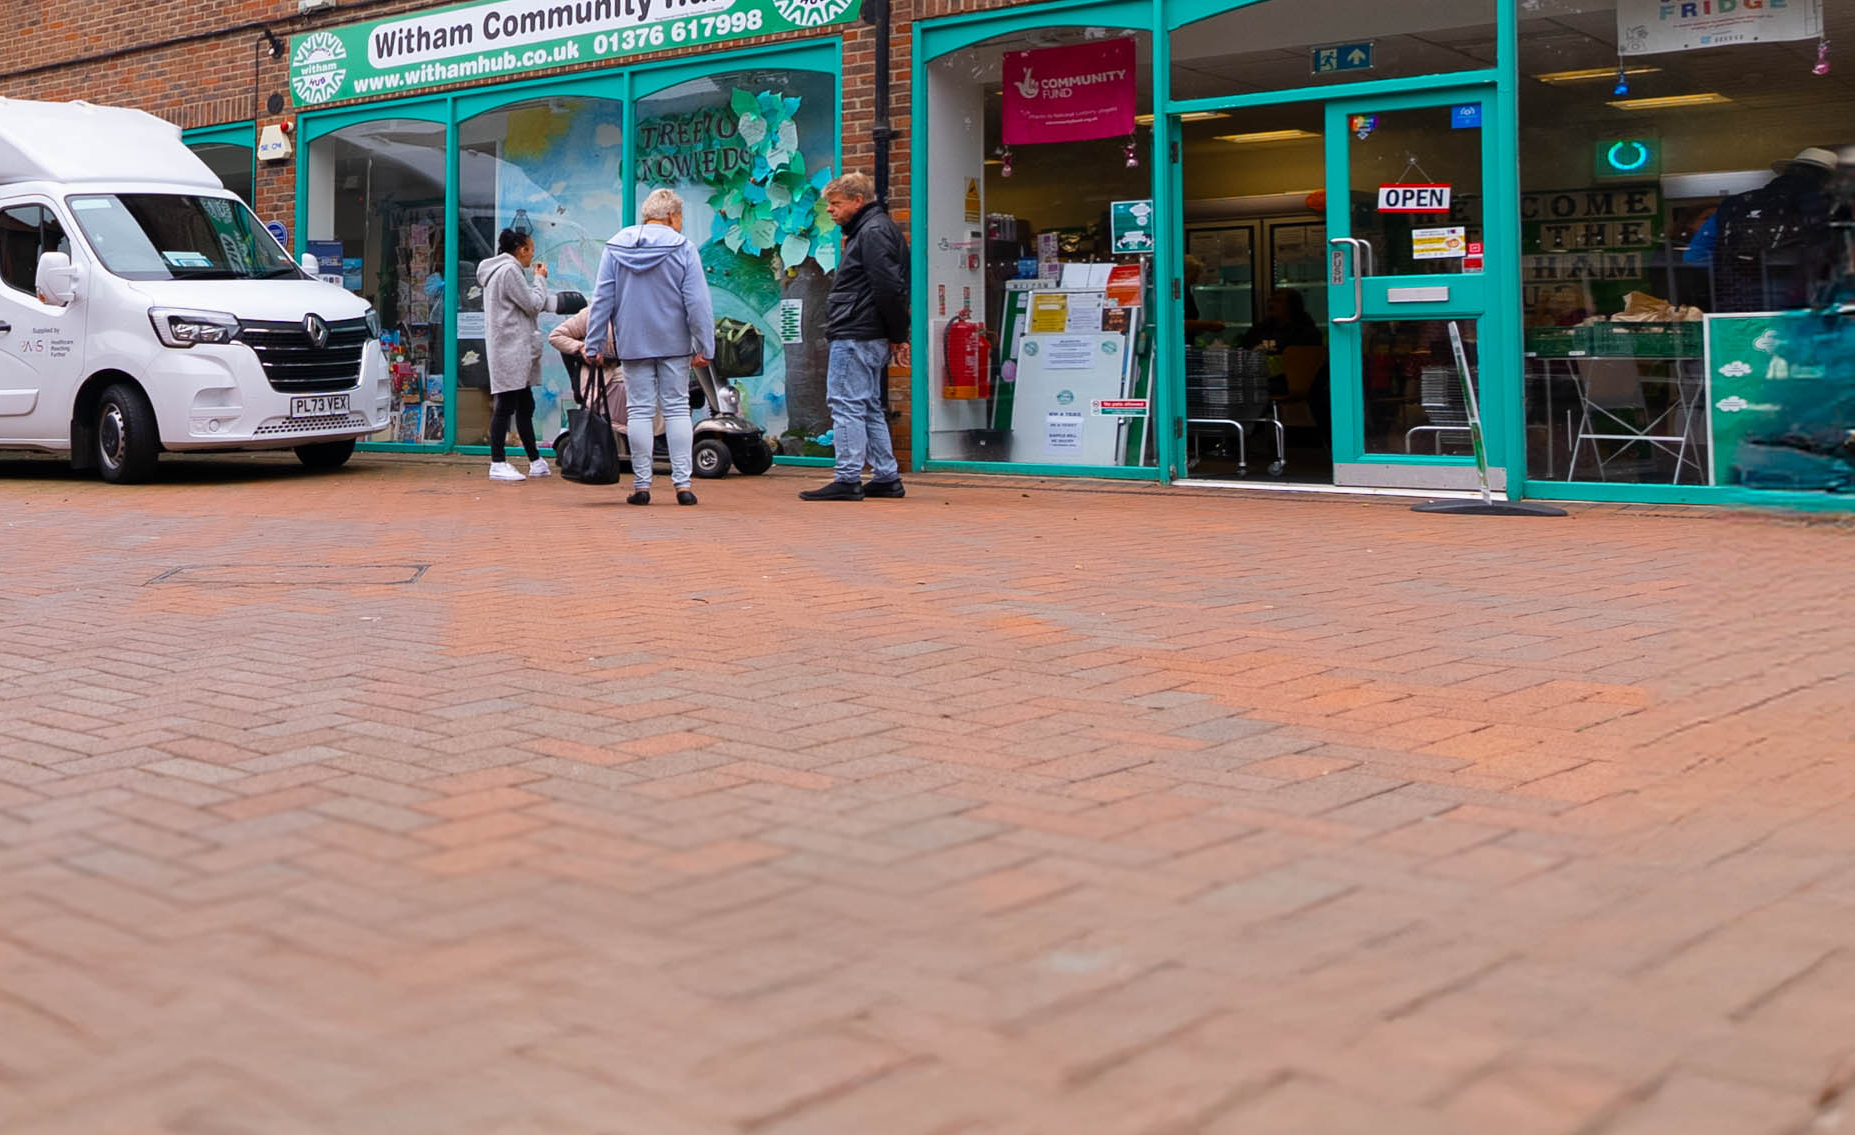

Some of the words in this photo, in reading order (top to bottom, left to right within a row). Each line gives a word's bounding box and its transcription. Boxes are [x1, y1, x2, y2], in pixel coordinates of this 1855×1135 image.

[374, 22, 473, 59] Witham
[353, 40, 580, 94] www.withamhub.co.uk
[593, 26, 665, 55] 01376
[670, 8, 764, 43] 617998
[300, 62, 338, 75] witham
[1040, 69, 1127, 89] COMMUNITY
[1042, 88, 1073, 100] FUND
[1385, 188, 1444, 207] OPEN
[1333, 251, 1343, 284] PUSH
[296, 398, 325, 414] PL73
[327, 396, 347, 410] VEX
